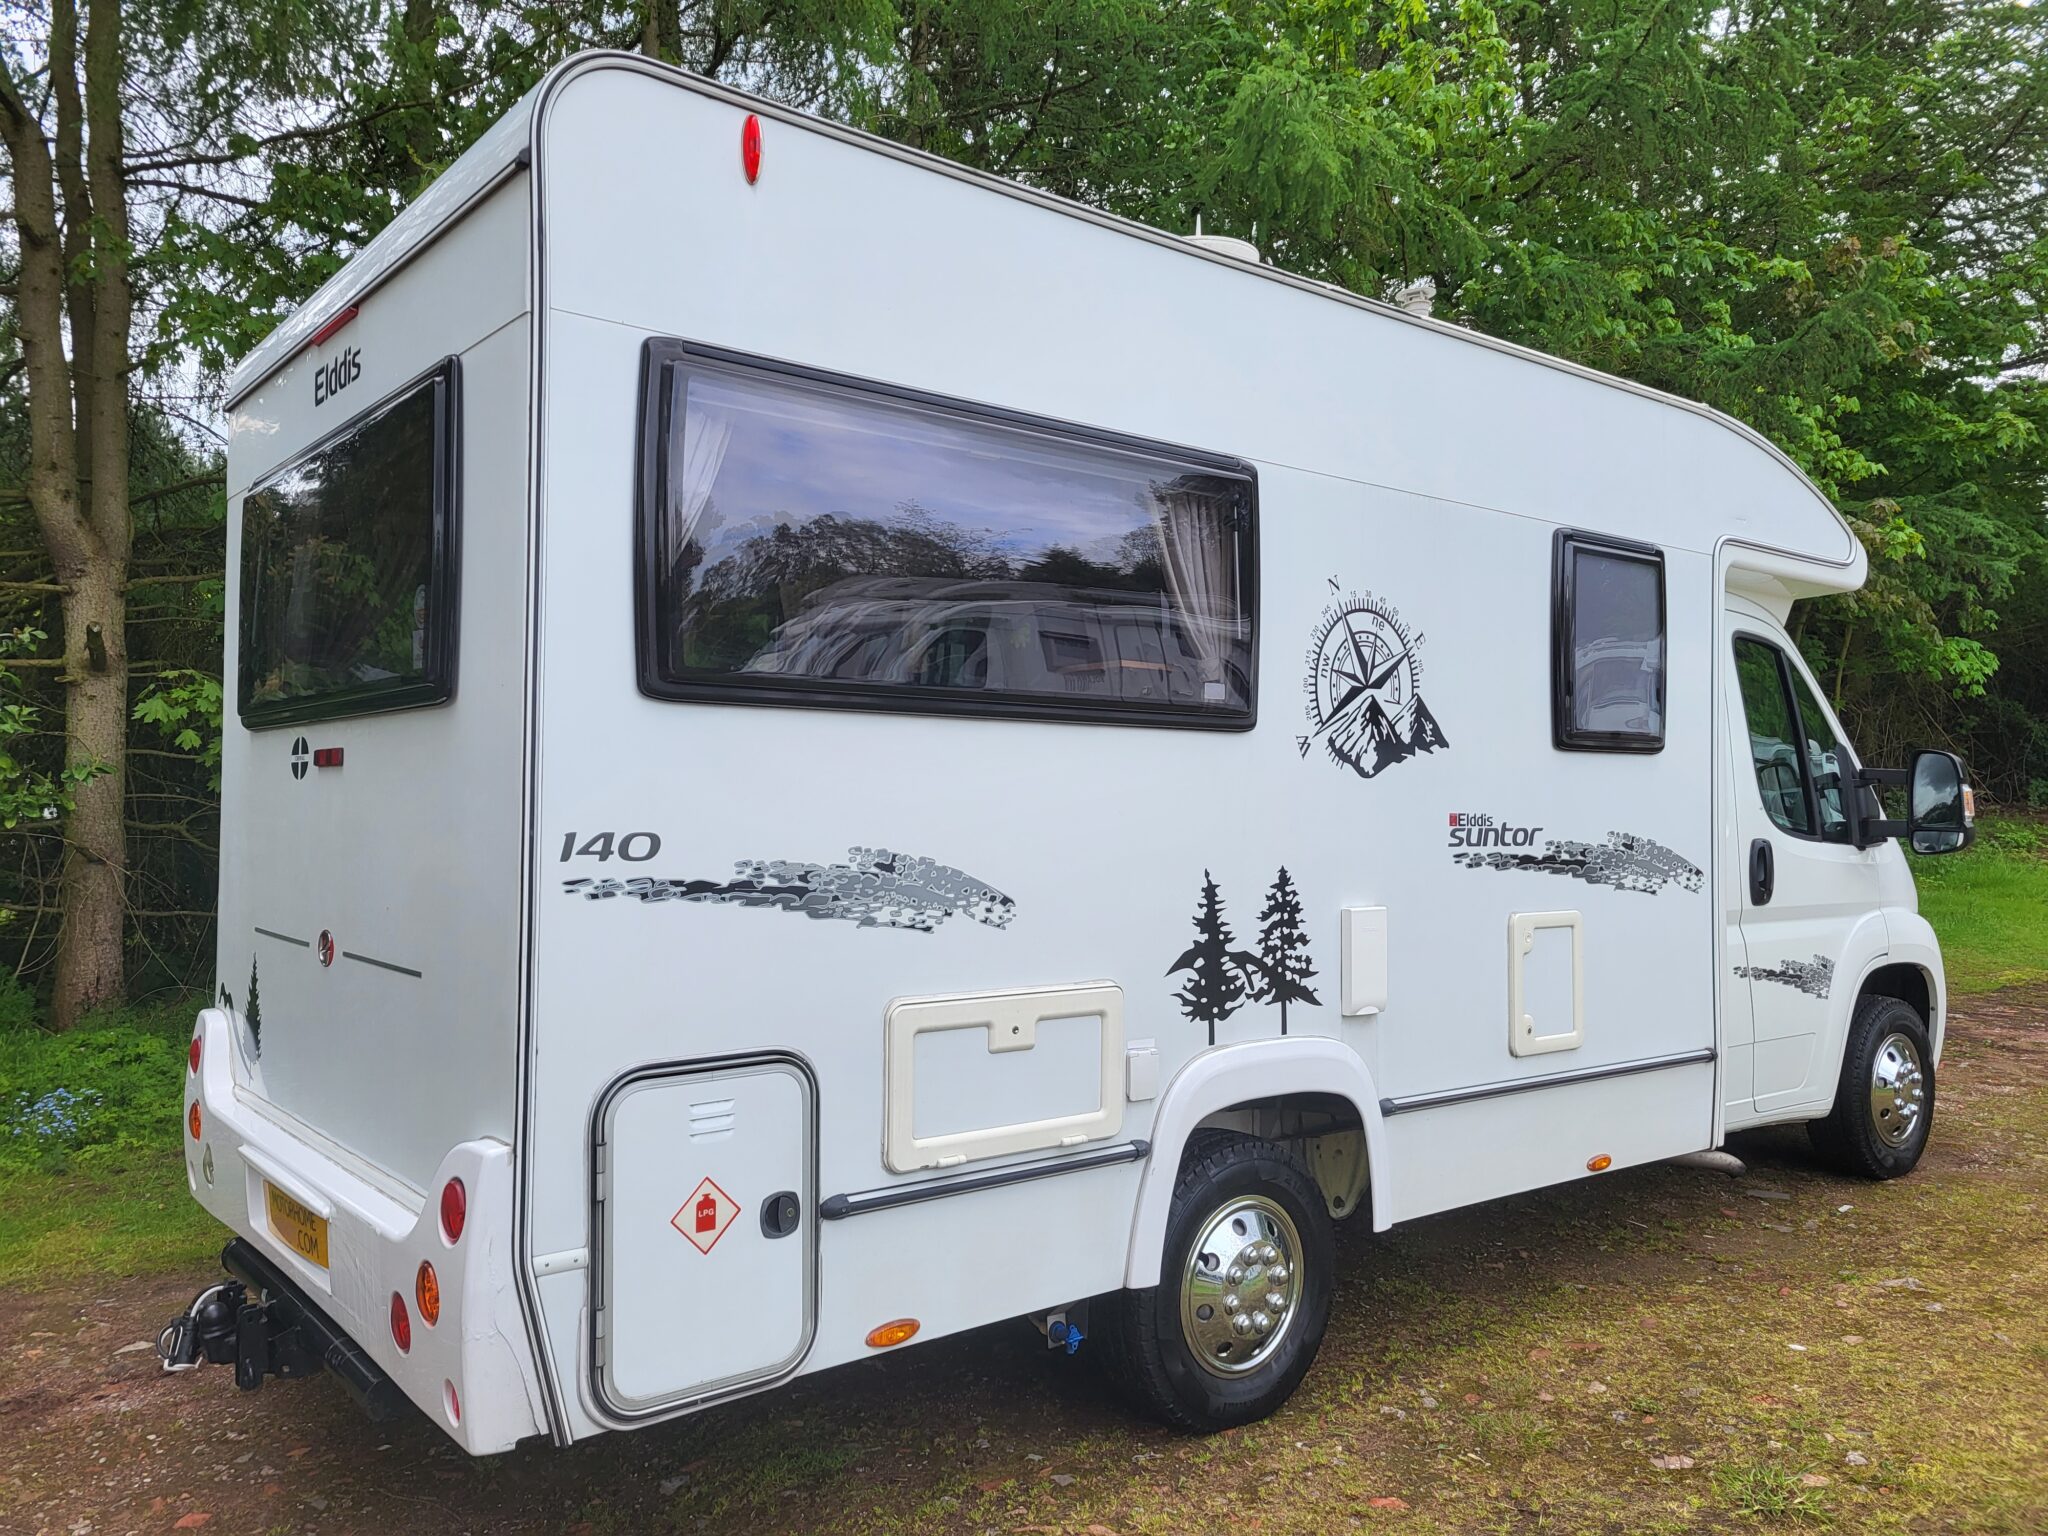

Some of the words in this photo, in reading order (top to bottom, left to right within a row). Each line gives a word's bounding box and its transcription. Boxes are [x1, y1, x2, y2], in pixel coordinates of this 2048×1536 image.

[314, 346, 362, 408] Elddis
[1327, 574, 1340, 596] N
[1371, 616, 1385, 631] ne
[1413, 631, 1426, 650] E
[1320, 652, 1331, 679] nw
[1457, 813, 1493, 827] Elddis
[1447, 821, 1544, 848] suntor
[559, 831, 662, 863] 140
[698, 1208, 714, 1218] LPG
